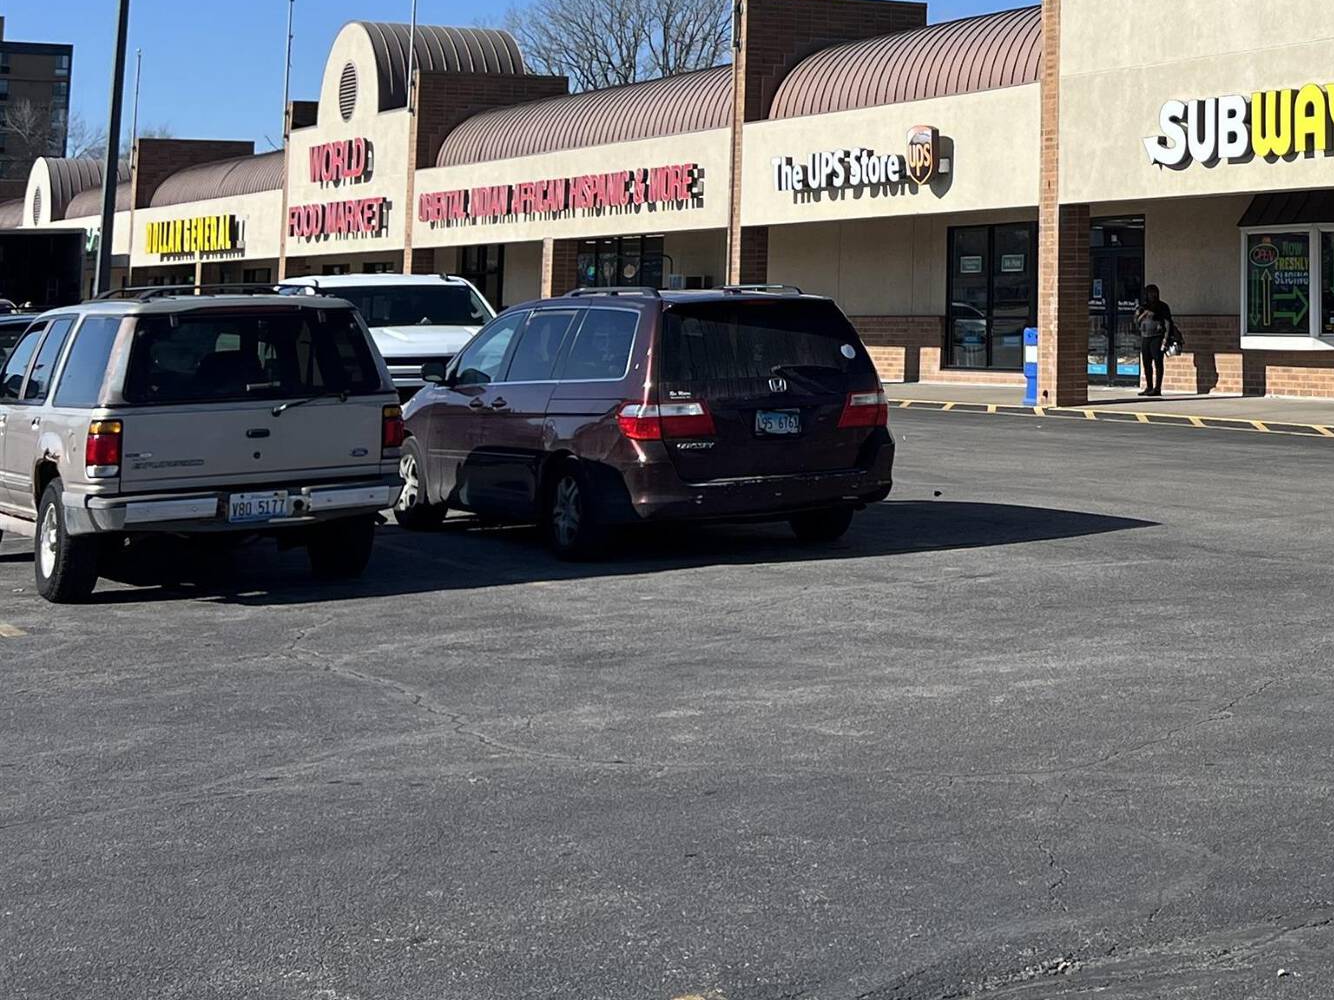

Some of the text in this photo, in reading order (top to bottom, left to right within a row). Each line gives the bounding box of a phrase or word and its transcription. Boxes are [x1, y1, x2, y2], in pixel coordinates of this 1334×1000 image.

[309, 137, 366, 183] WORLD
[771, 148, 900, 191] The UPS Store
[908, 143, 931, 176] ups
[418, 163, 693, 222] ORIENTAL INDIAN AFRICAN HISPANIC & MORE
[145, 218, 182, 253] DOLLAR
[183, 214, 231, 252] GENERAL
[289, 197, 384, 237] FOOD MARKET
[1274, 271, 1309, 285] SLICING
[1275, 257, 1309, 270] FRESHLY
